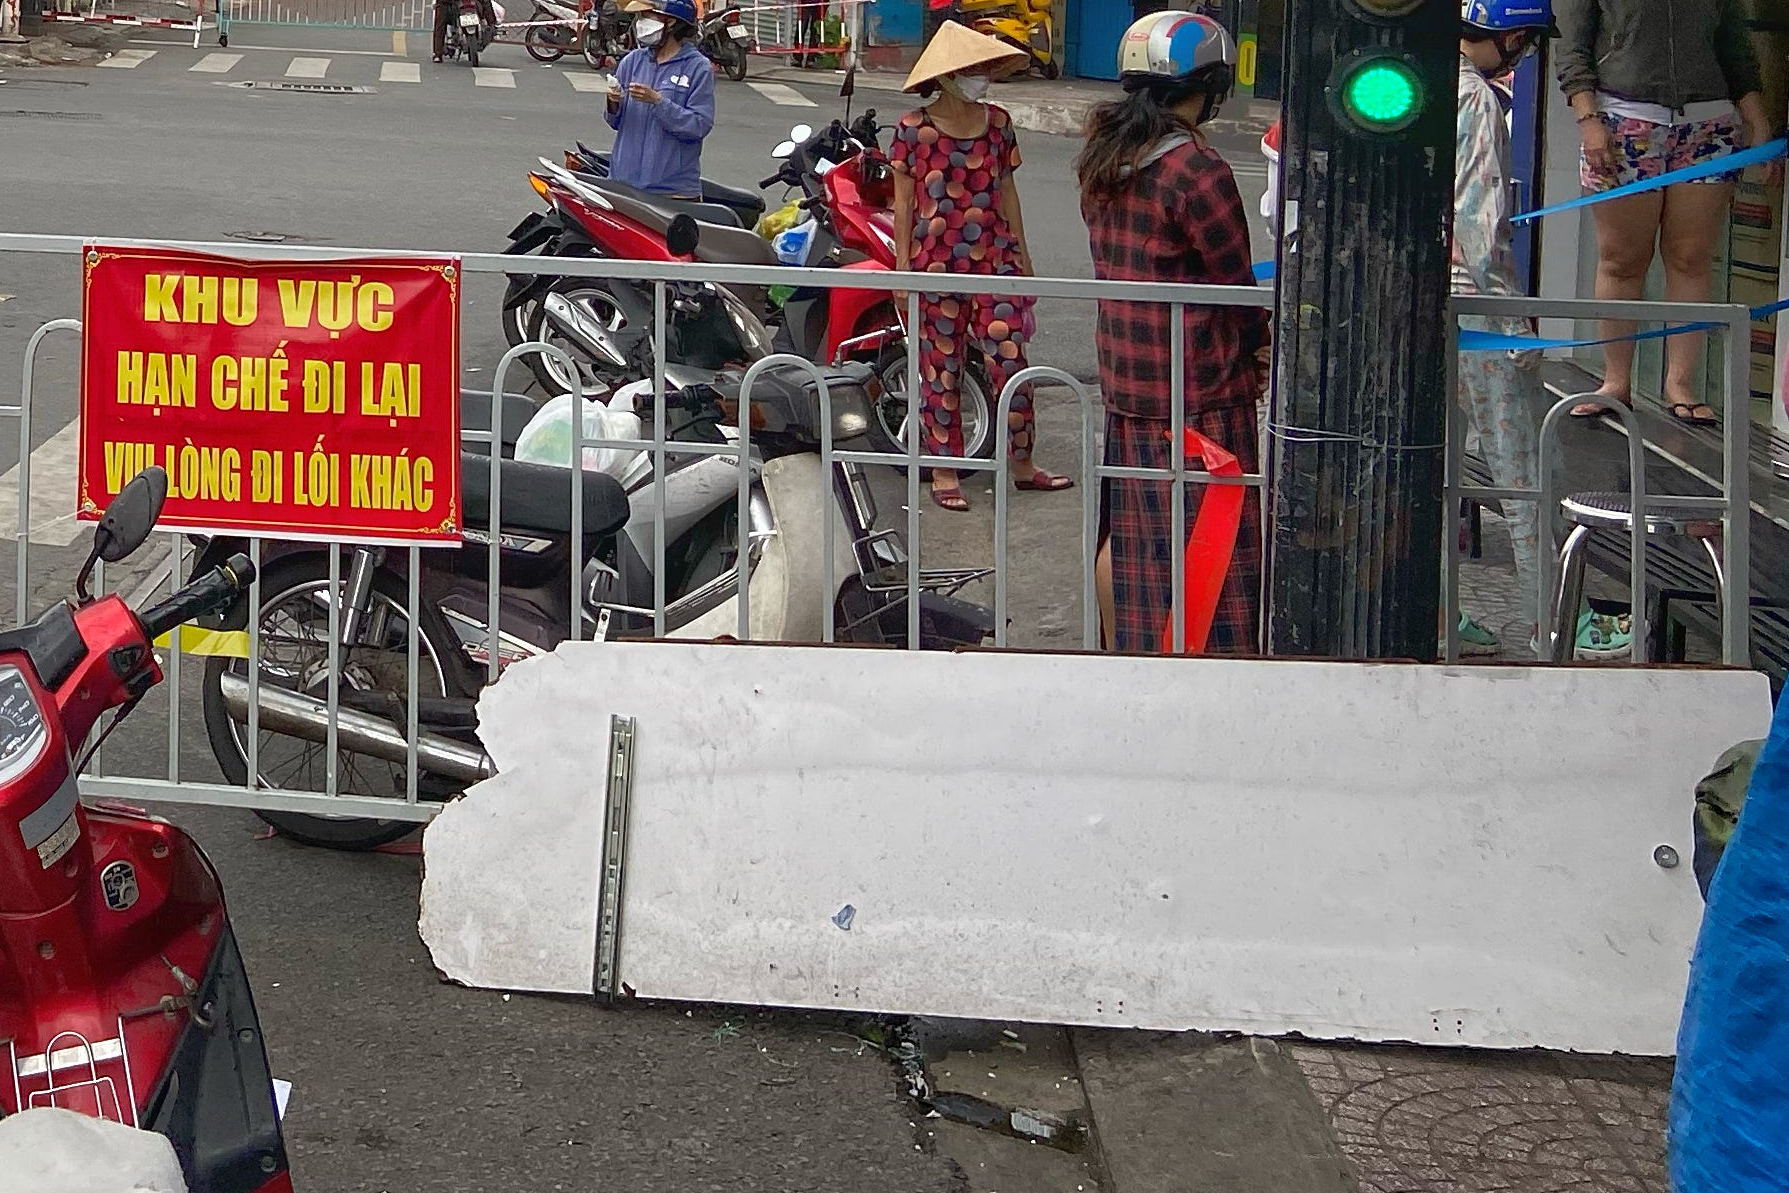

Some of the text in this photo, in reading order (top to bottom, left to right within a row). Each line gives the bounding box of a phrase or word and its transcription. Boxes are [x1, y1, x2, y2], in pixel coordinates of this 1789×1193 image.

[143, 273, 395, 339] KHU VỰC
[116, 339, 422, 428] HẠN CHẾ ĐI LẠI
[165, 436, 241, 503] LÒNG
[250, 449, 283, 504] ĐI
[293, 433, 340, 508] LỐI
[349, 446, 435, 513] KHÁC
